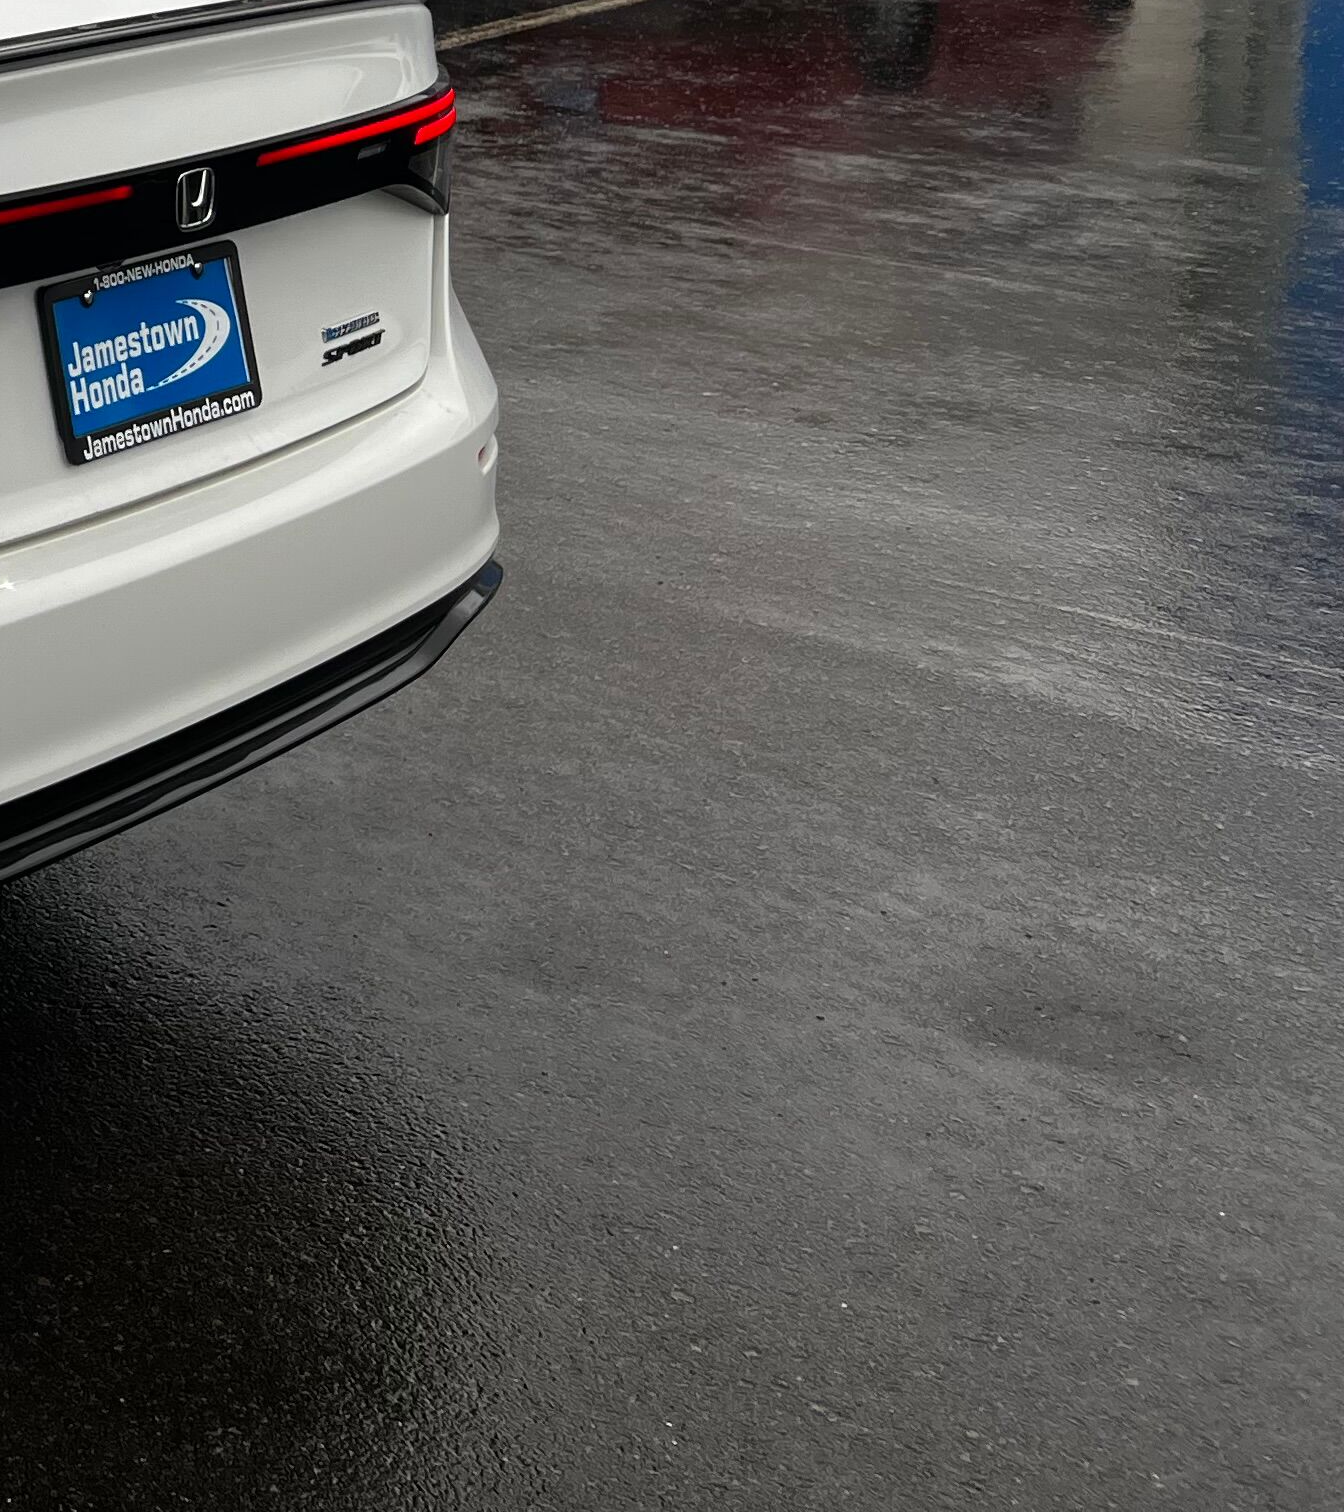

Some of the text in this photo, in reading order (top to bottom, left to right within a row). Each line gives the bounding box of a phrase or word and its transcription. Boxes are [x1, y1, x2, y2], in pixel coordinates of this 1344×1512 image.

[93, 253, 195, 291] 1-800-NEW-HONDA
[67, 315, 200, 378] Jamestown
[70, 362, 146, 416] Honda
[83, 390, 256, 461] JamestownHonda.com
